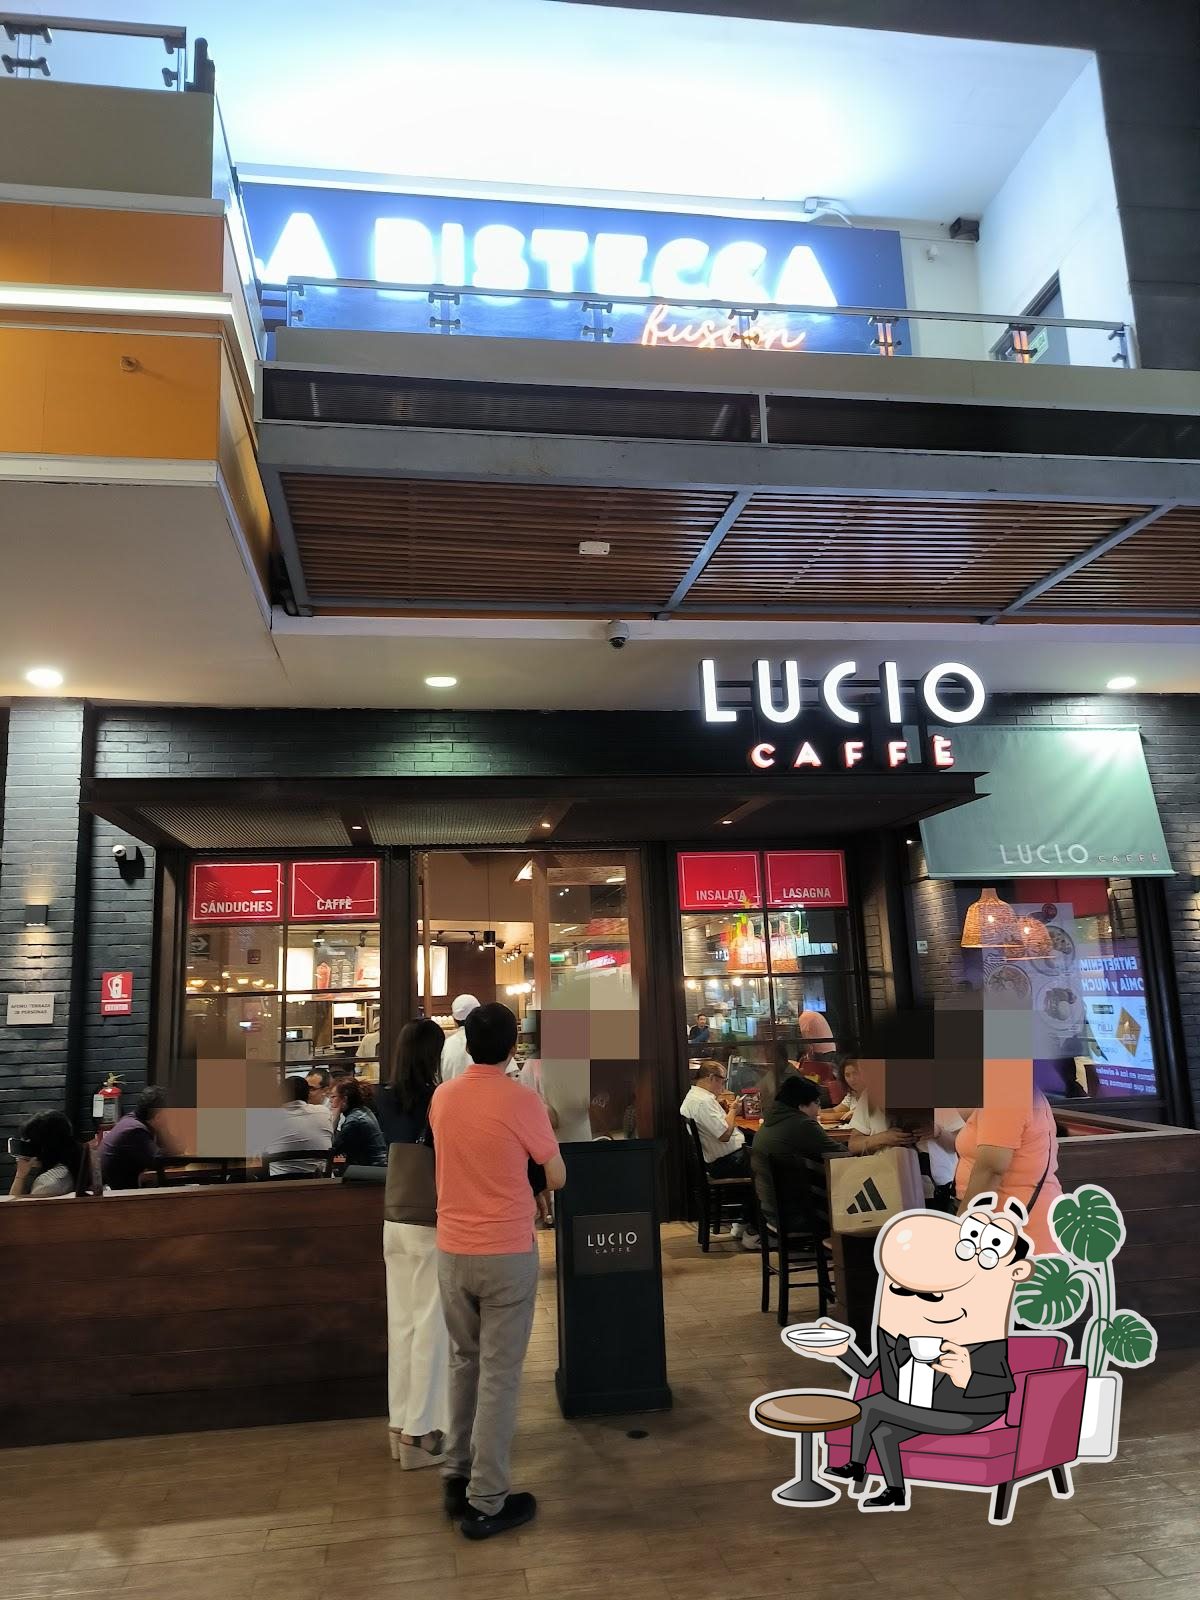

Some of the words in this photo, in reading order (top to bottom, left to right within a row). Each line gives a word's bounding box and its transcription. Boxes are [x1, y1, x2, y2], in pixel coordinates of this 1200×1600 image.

[700, 659, 986, 724] LUCIO
[751, 734, 955, 768] CAFFÈ
[999, 843, 1089, 865] LUCIO
[696, 889, 747, 902] INSALATA
[782, 887, 832, 899] LASAGNA
[200, 900, 274, 914] SÁNDUCHES
[316, 896, 353, 911] CAFFÈ
[587, 1231, 638, 1247] LUCIO
